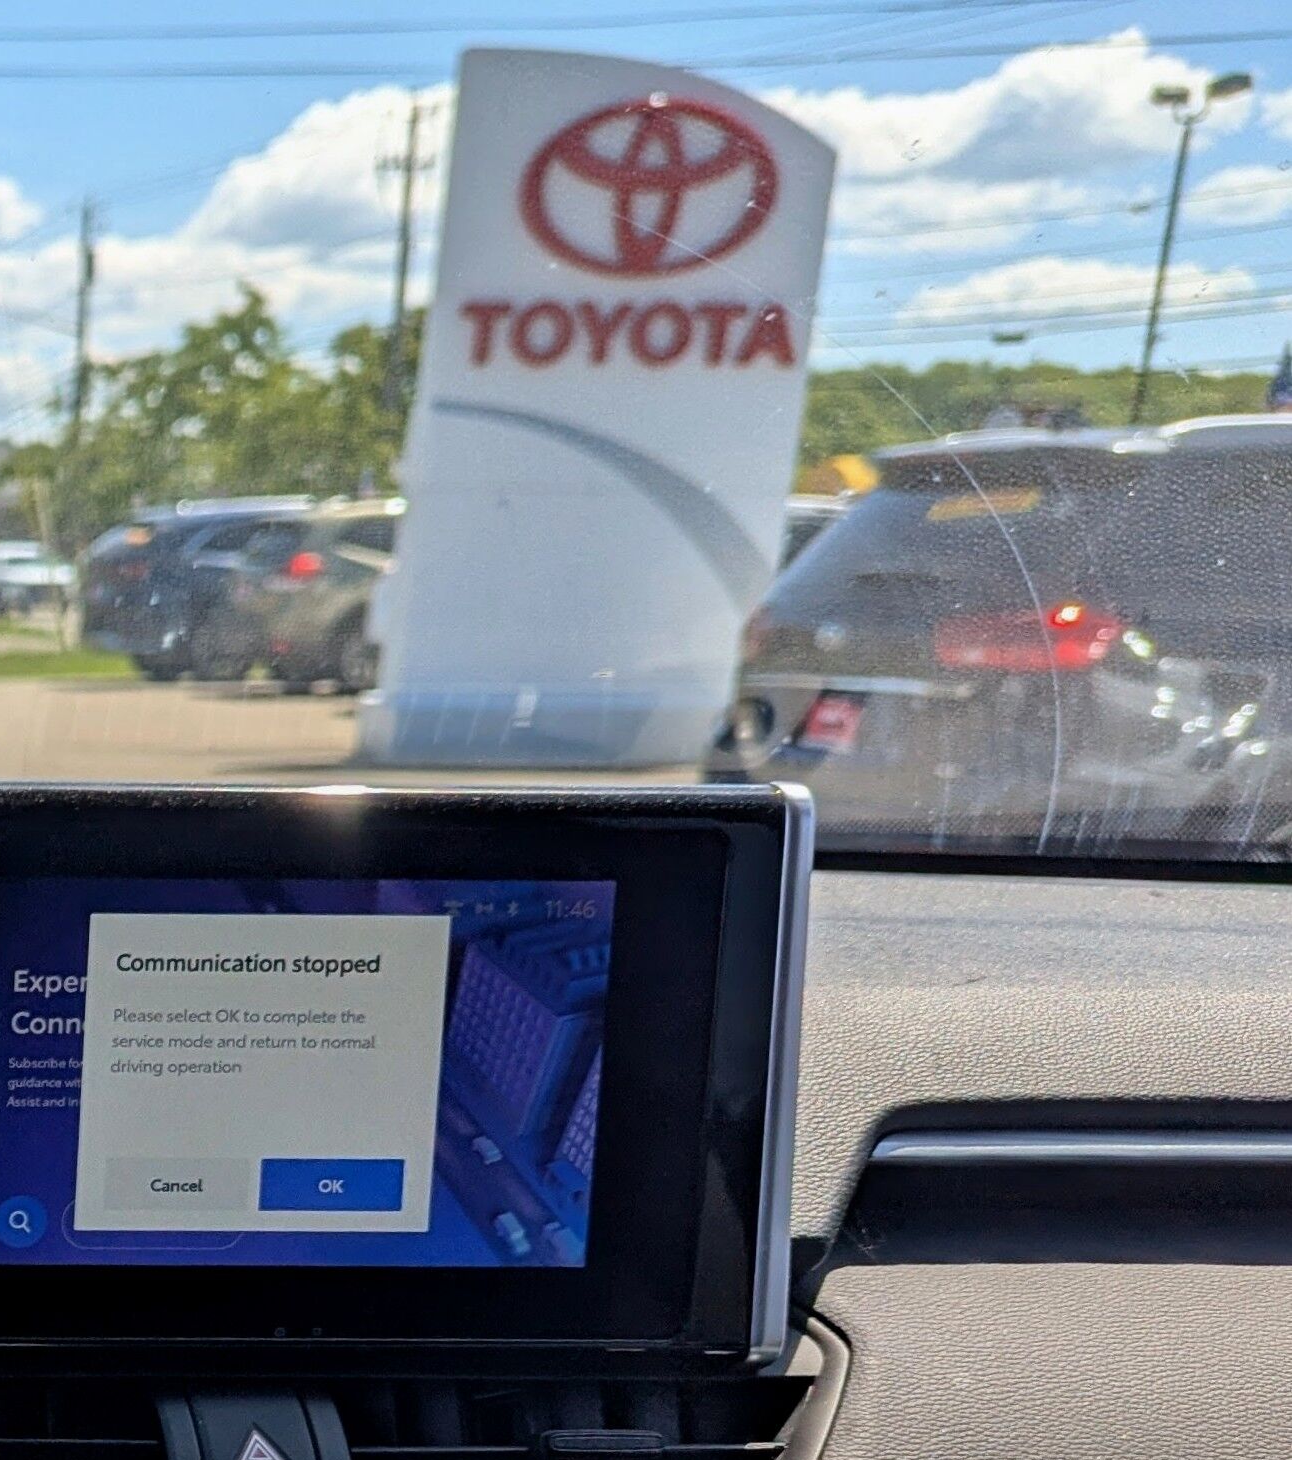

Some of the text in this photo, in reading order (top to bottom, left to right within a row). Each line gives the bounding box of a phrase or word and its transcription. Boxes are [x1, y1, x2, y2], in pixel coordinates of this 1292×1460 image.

[462, 301, 795, 367] TOYOTA
[546, 900, 596, 919] 11:46
[116, 953, 381, 977] Communication stopped
[11, 1011, 85, 1034] Conn
[113, 1008, 365, 1027] Please select OK to complete the
[111, 1035, 376, 1049] service mode and return to normal
[8, 1057, 67, 1069] Subscribe
[110, 1060, 242, 1077] driving operation
[7, 1077, 62, 1091] guidance
[6, 1095, 41, 1108] Assist
[42, 1097, 65, 1108] and
[150, 1178, 344, 1194] Cancel OK
